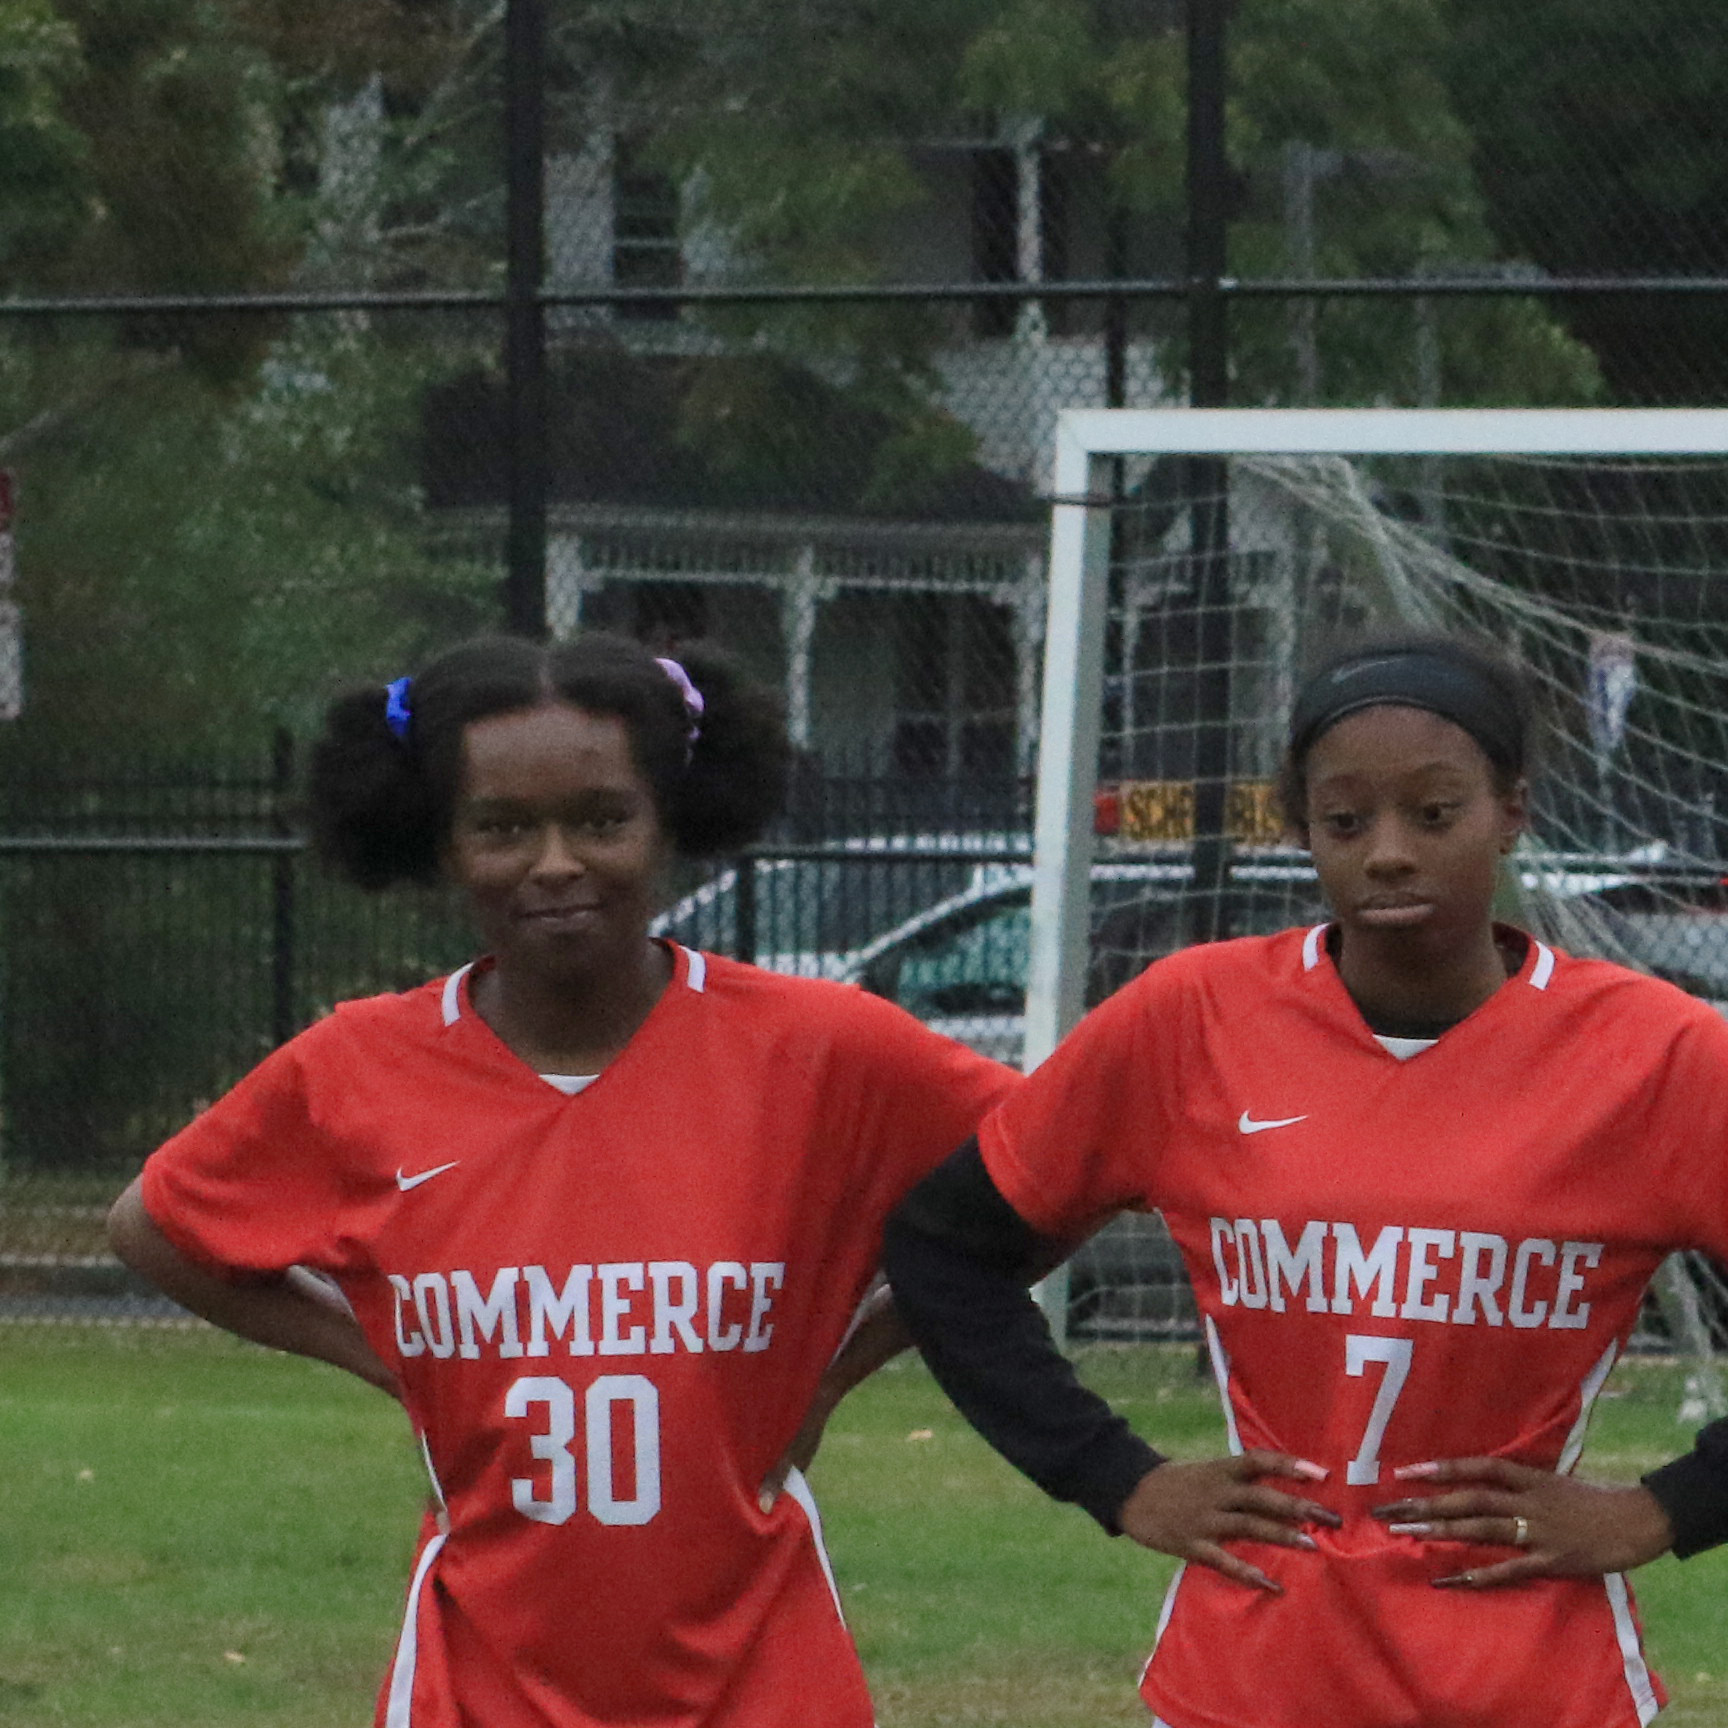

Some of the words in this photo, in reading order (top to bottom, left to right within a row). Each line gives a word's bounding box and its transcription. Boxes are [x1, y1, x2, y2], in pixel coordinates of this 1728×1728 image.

[388, 1261, 786, 1360] COMMERCE
[1210, 1216, 1605, 1330] COMMERCE
[504, 1374, 662, 1526] 30
[1345, 1333, 1415, 1485] 7
